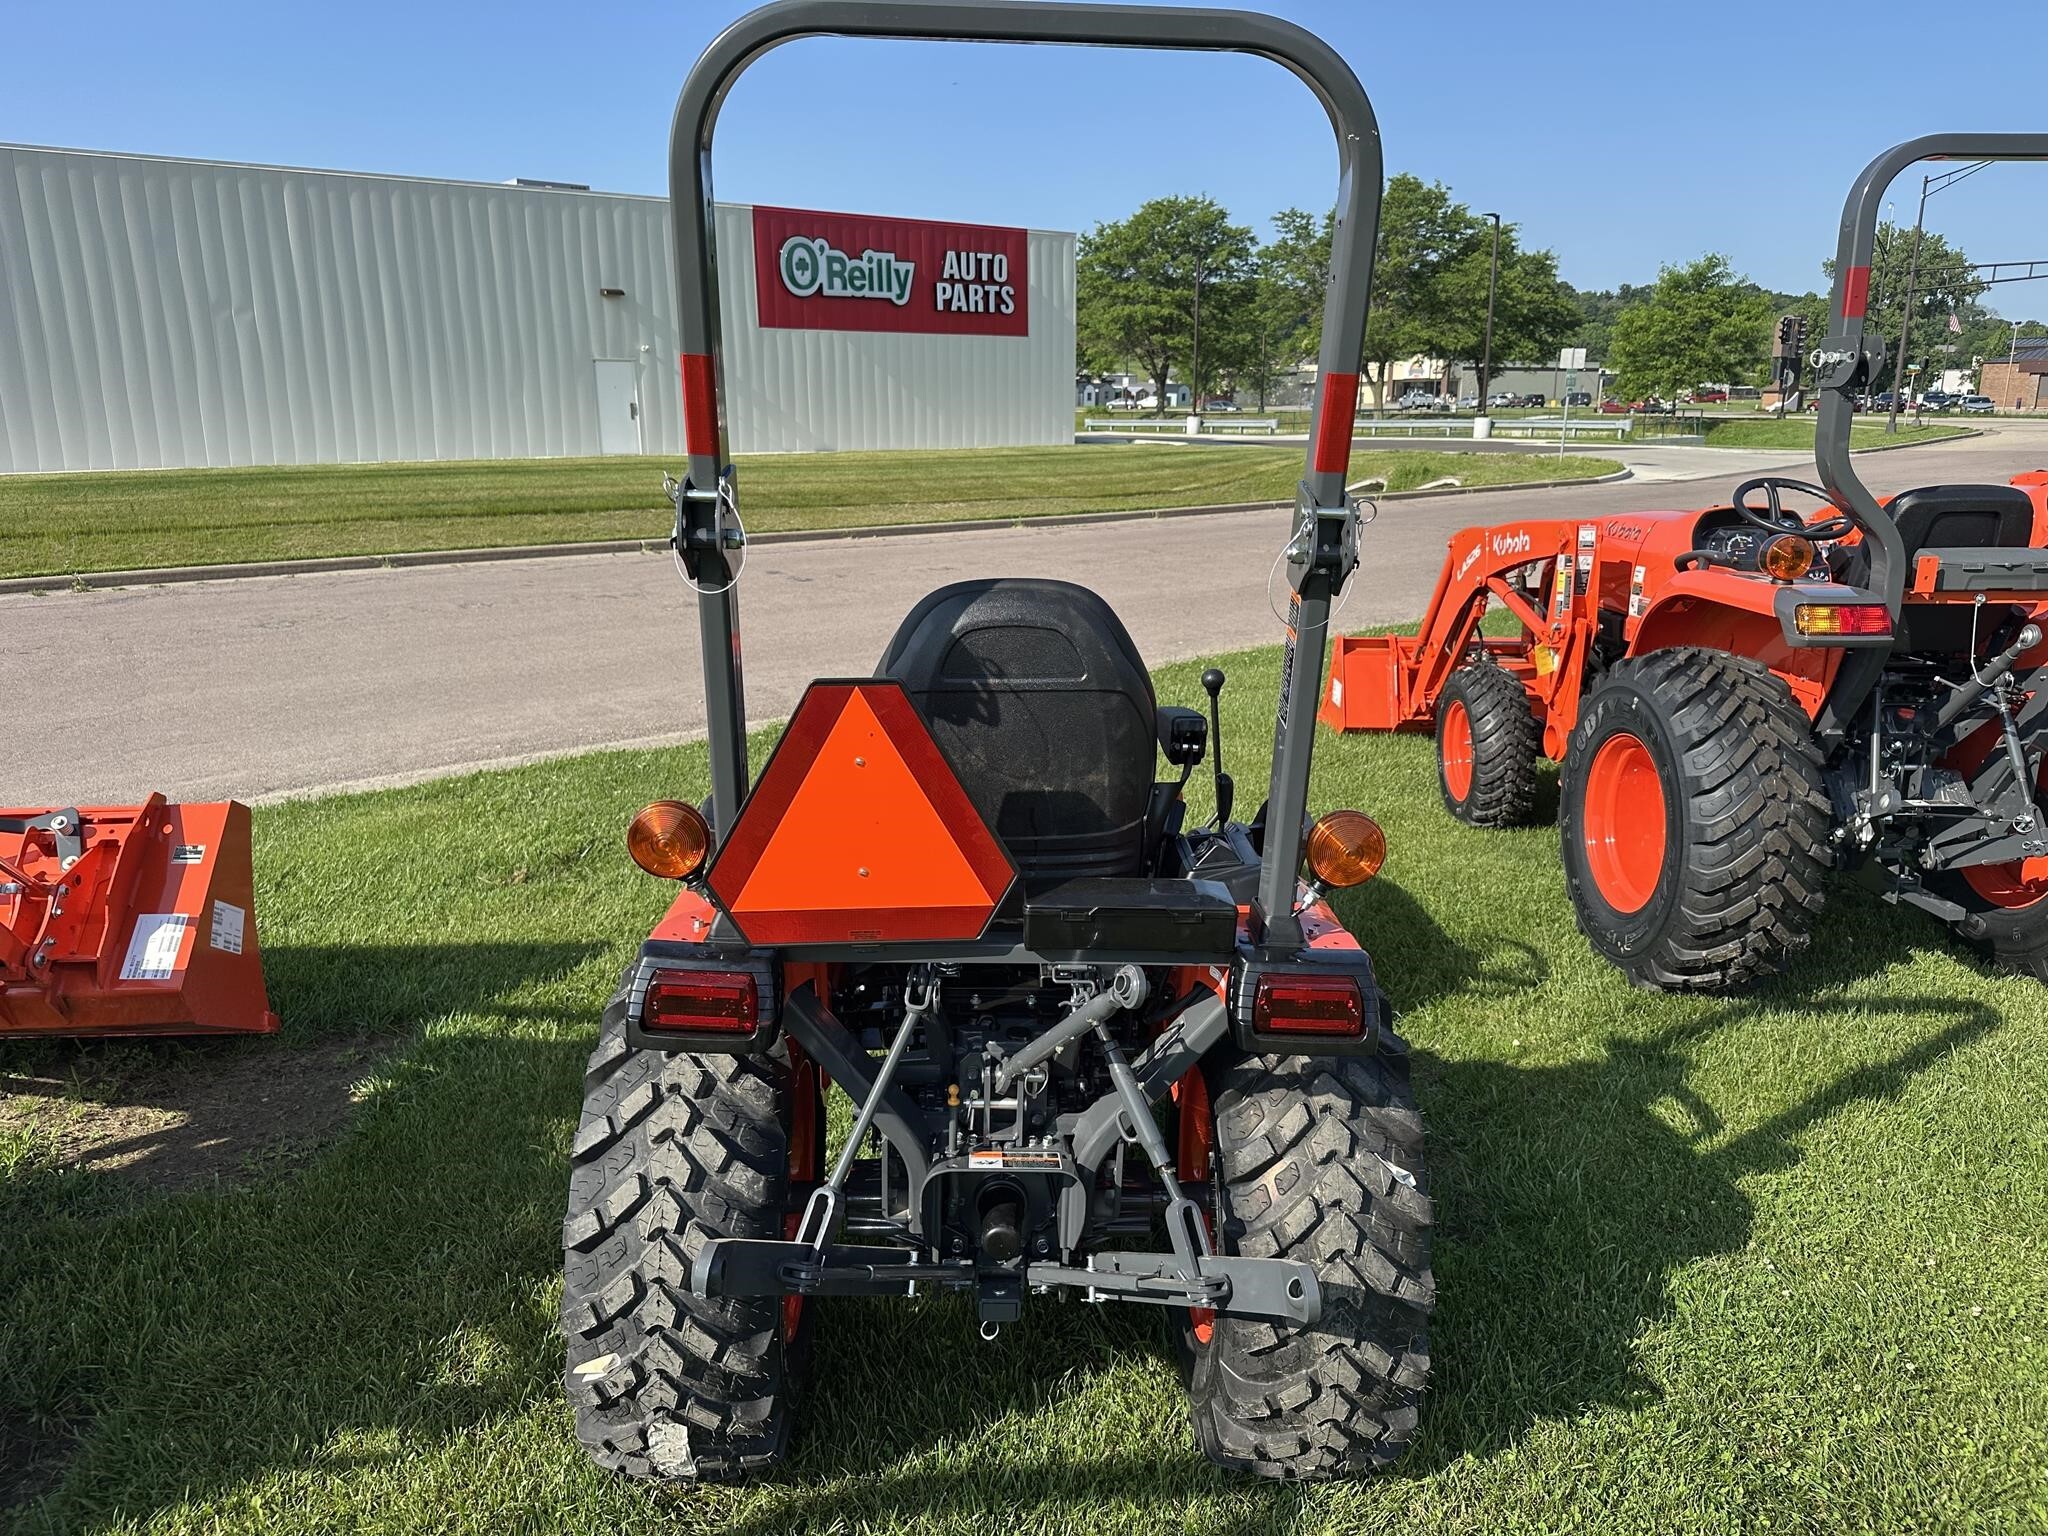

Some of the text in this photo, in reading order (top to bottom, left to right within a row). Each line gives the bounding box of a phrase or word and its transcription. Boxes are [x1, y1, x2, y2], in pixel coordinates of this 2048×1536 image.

[784, 240, 913, 301] O'Reilly
[943, 250, 1008, 282] AUTO
[936, 282, 1015, 315] PARTS
[1492, 529, 1530, 556] Kubota
